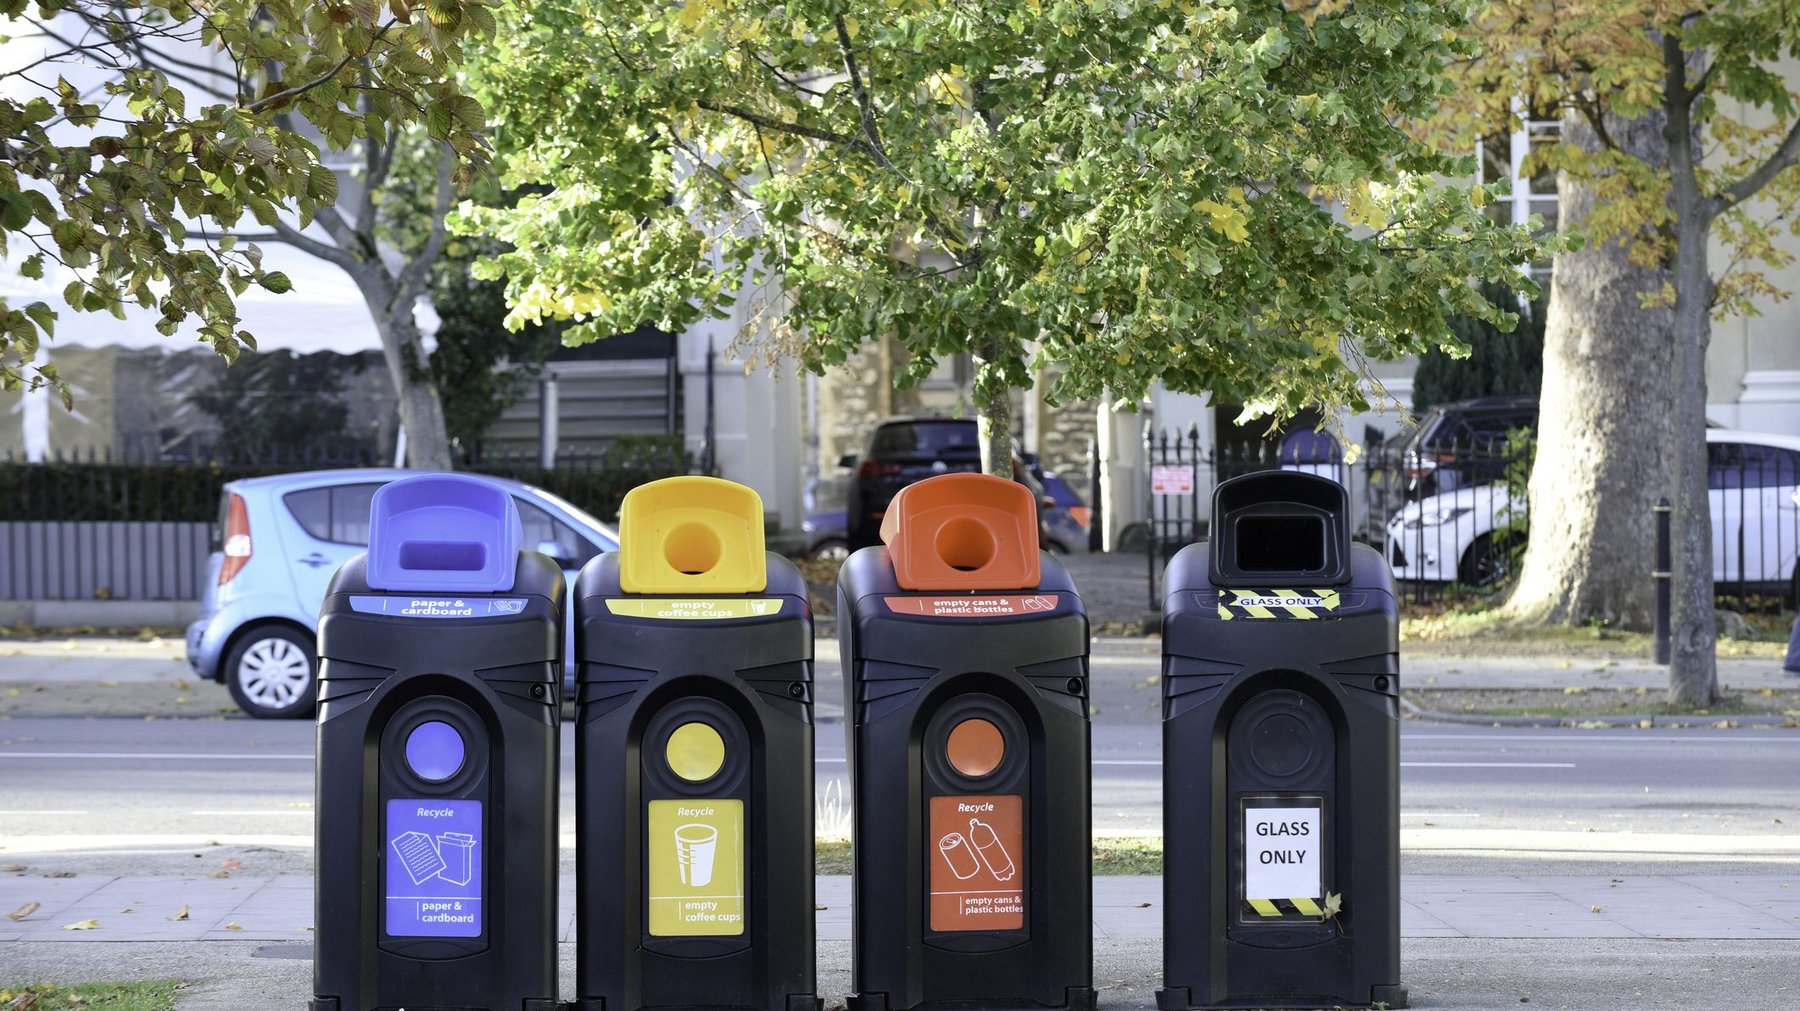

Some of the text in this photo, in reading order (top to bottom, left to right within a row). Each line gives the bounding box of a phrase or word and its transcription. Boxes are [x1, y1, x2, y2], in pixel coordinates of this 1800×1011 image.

[411, 600, 451, 608] paper
[671, 602, 716, 610] empty
[933, 599, 970, 608] empty
[1240, 598, 1321, 606] GLASS ONLY
[402, 607, 472, 616] cardboard
[657, 609, 733, 618] coffee cups
[934, 606, 972, 615] plastic
[417, 807, 454, 819] Recycle
[677, 807, 714, 818] Recycle
[958, 803, 994, 813] Recycle
[1256, 821, 1310, 836] GLASS
[1260, 850, 1306, 864] ONLY
[965, 896, 1021, 906] empty cans &
[422, 901, 462, 912] paper &
[685, 902, 718, 911] empty
[965, 904, 1023, 915] plastic bottles
[422, 913, 474, 923] cardboard
[685, 912, 741, 923] coffee cups
